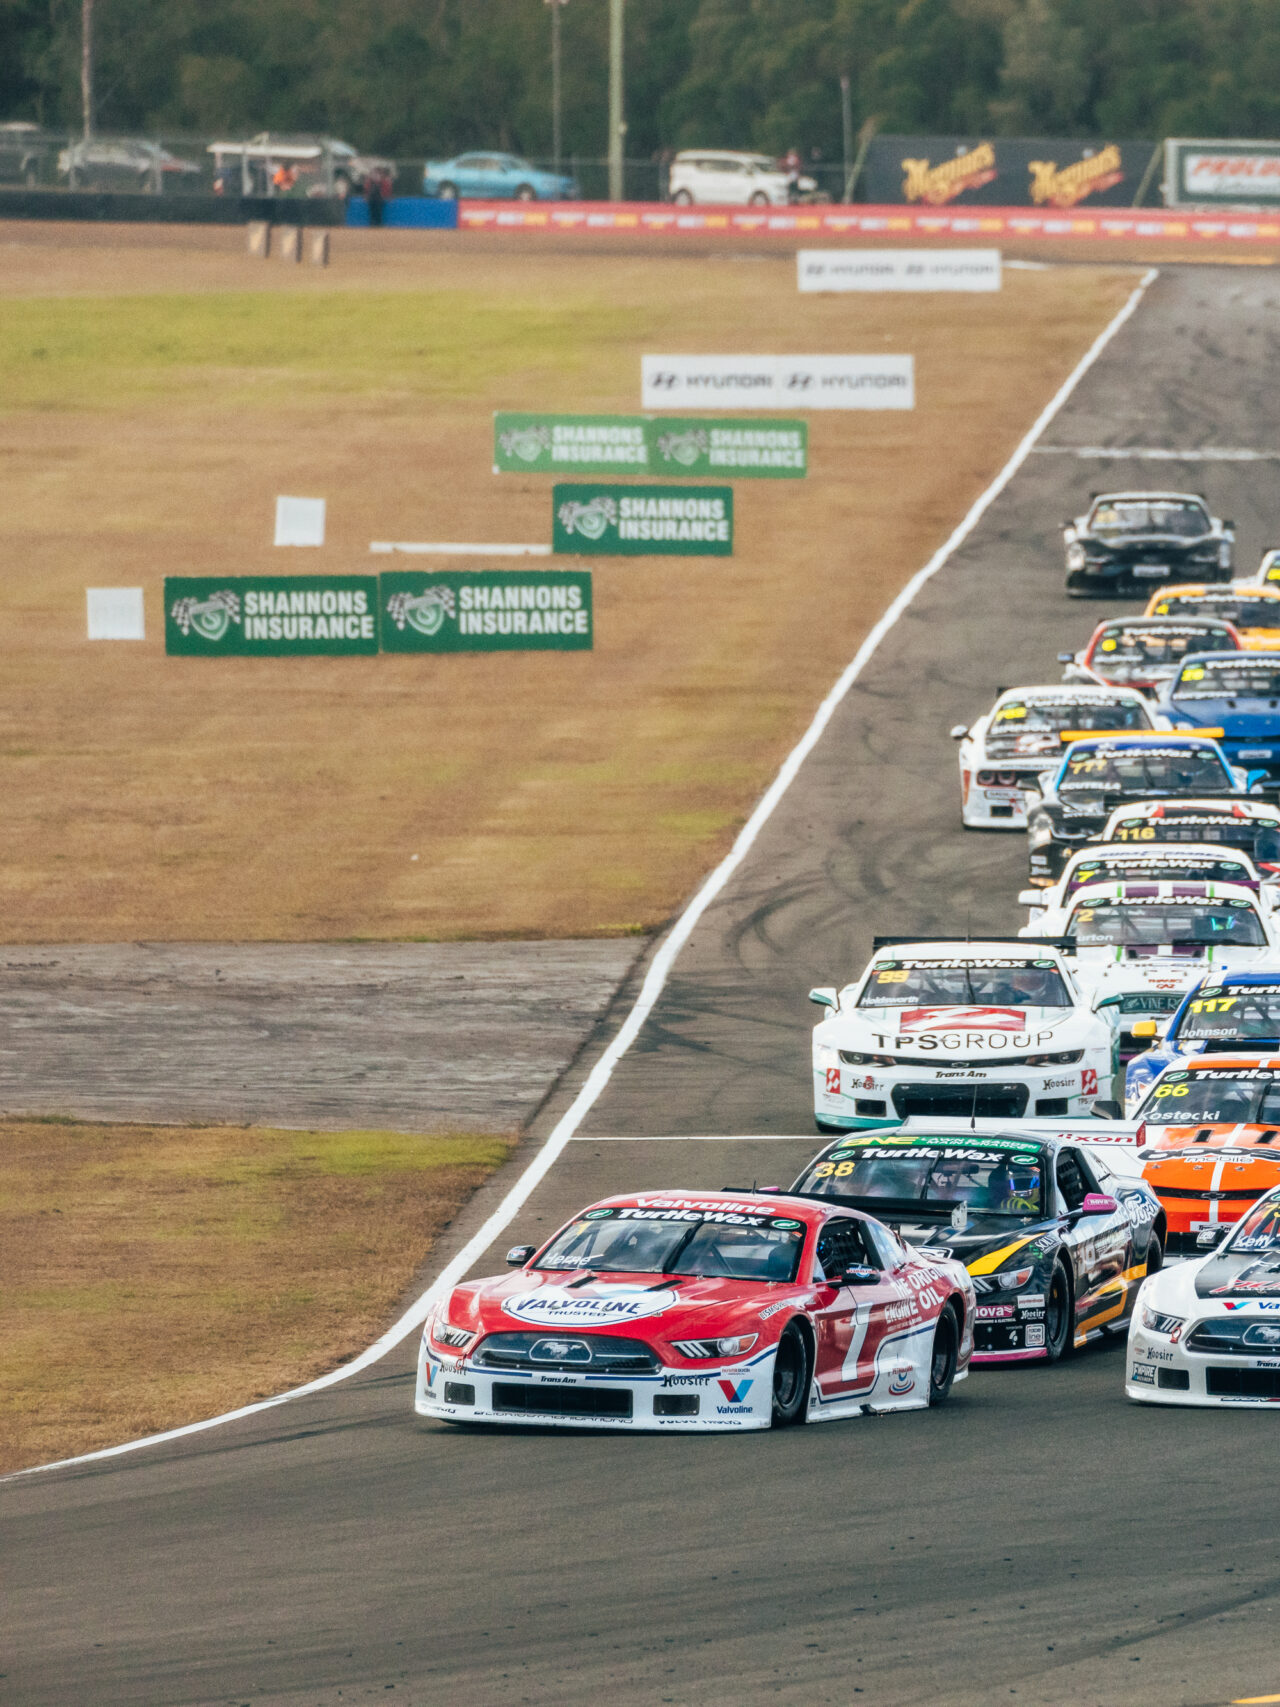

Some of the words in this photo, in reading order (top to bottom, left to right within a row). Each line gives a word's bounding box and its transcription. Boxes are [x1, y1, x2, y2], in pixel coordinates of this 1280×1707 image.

[686, 375, 772, 389] HYUNDAI
[821, 375, 907, 389] HYUNDAI
[552, 425, 644, 445] SHANNONS
[710, 429, 801, 449] SHANNONS
[552, 443, 648, 464] INSURANCE
[710, 447, 805, 468] INSURANCE
[619, 498, 725, 521] SHANNONS
[619, 518, 729, 541] INSURANCE
[244, 590, 368, 616] SHANNONS
[459, 586, 582, 610] SHANNONS
[244, 614, 375, 640] INSURANCE
[459, 609, 588, 636] INSURANCE
[1189, 997, 1239, 1013] 117
[1154, 1083, 1190, 1099] 66
[815, 1160, 856, 1178] 38
[1185, 1155, 1255, 1164] mobile
[636, 1198, 777, 1216] Valvoline
[516, 1298, 648, 1315] VALVOLINE
[917, 1288, 946, 1311] OIL
[660, 1374, 711, 1387] Hoosier
[716, 1405, 754, 1414] Valvoline
